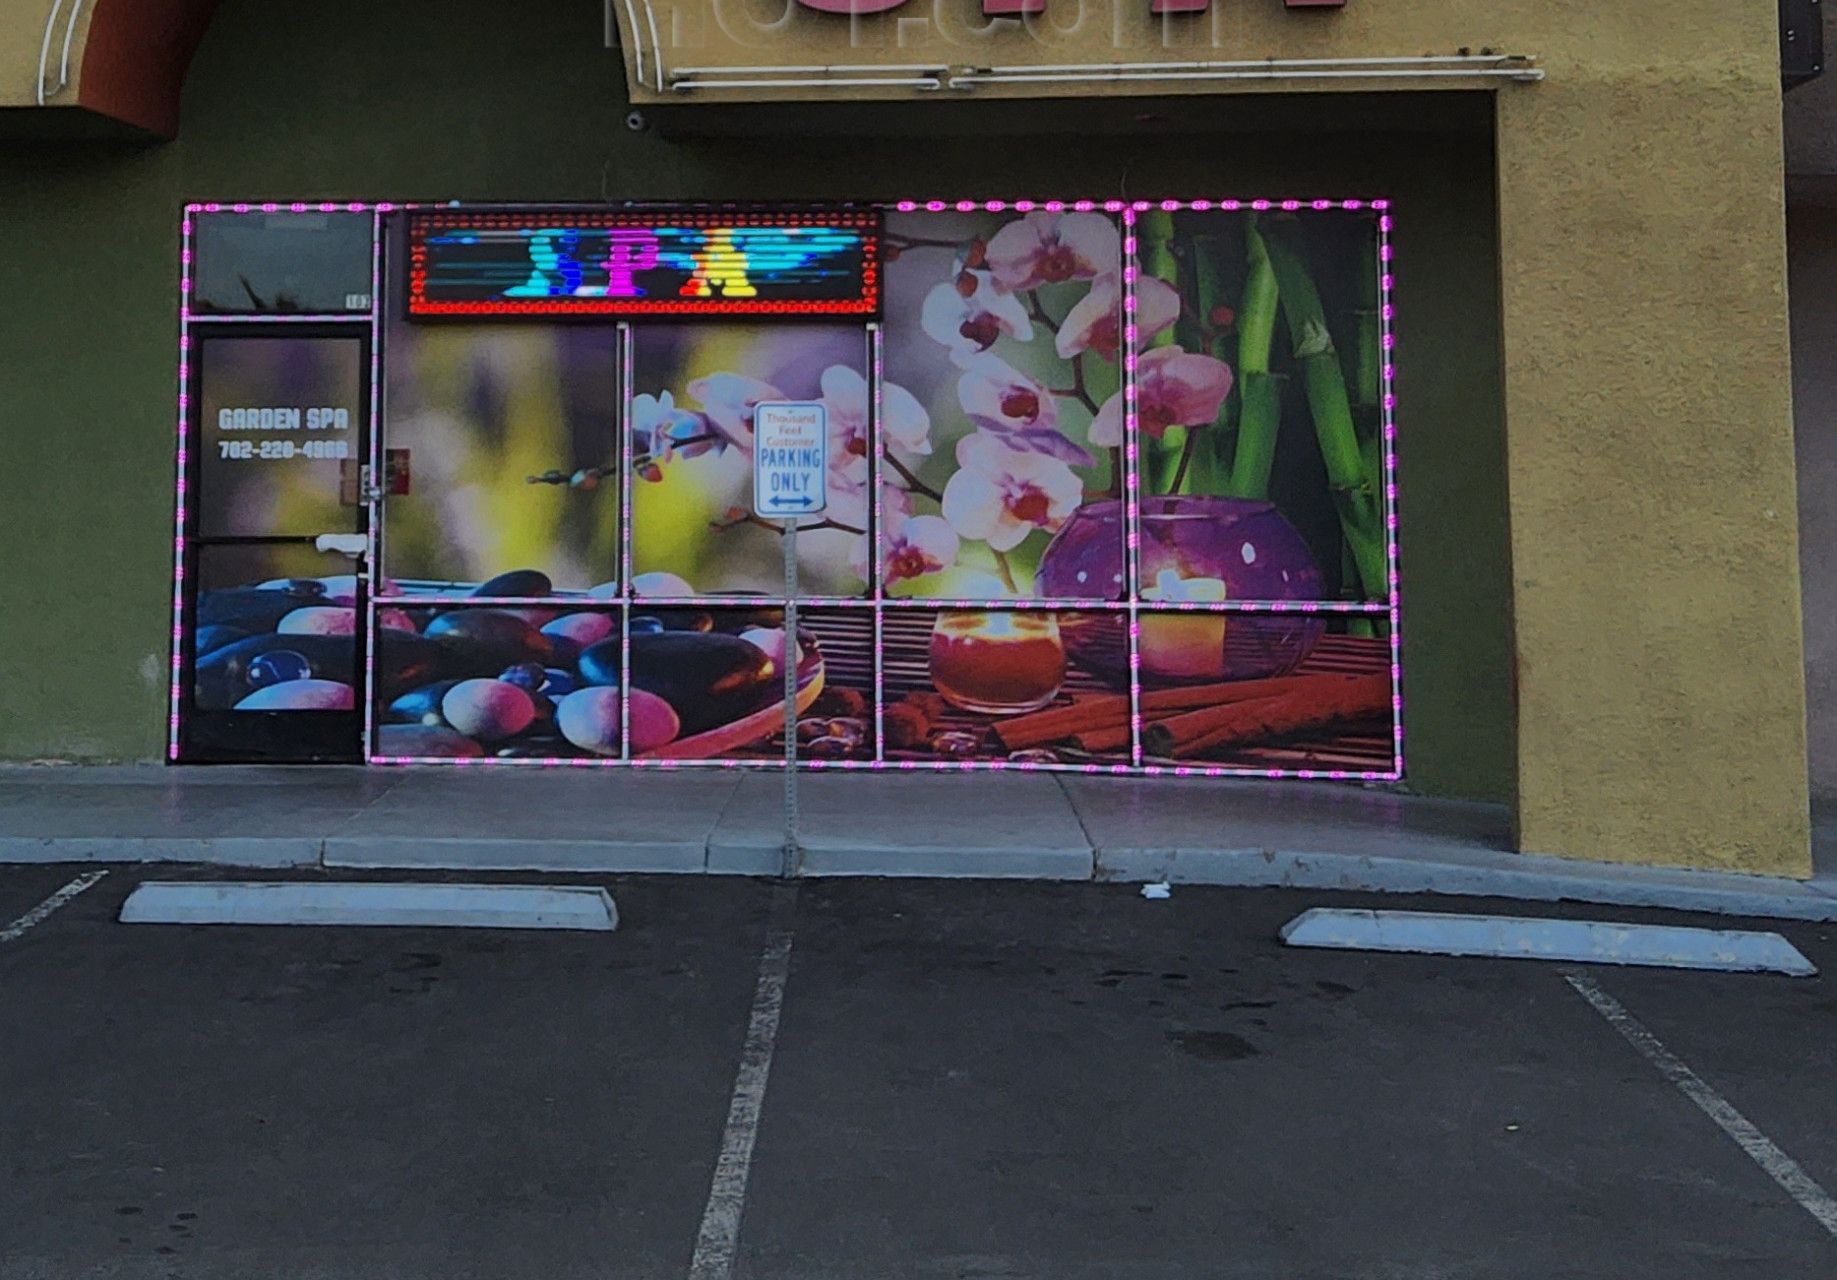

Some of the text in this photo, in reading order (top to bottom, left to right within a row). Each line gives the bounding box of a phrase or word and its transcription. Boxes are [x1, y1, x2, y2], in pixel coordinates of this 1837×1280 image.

[218, 408, 348, 430] GARDEN SPA
[761, 448, 821, 468] PARKING
[771, 472, 810, 491] ONLY
